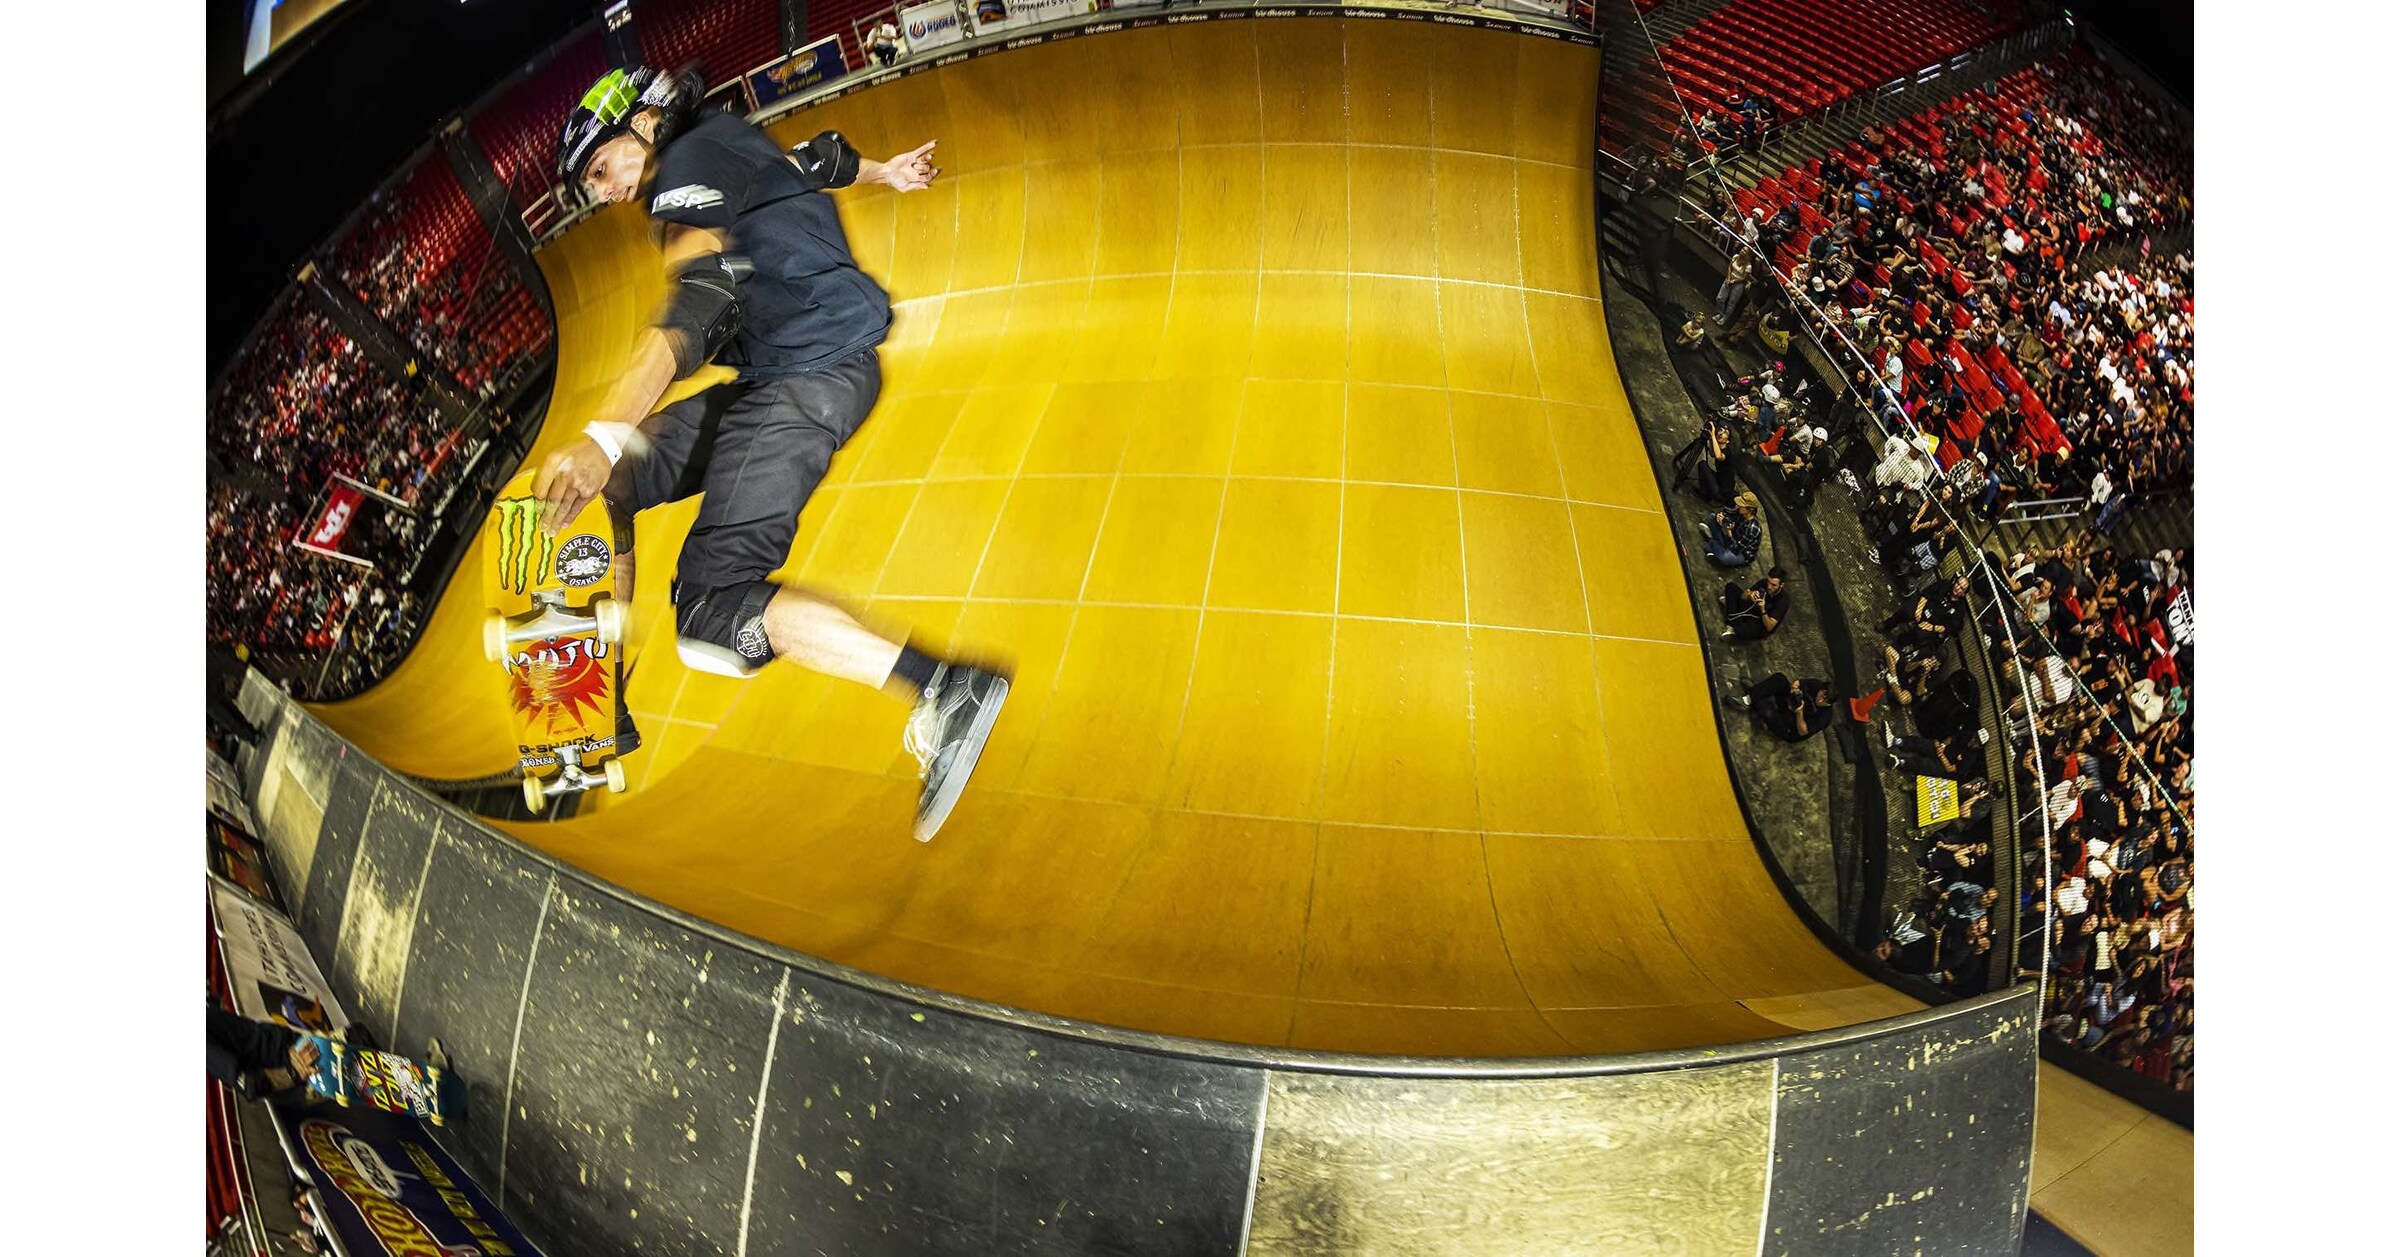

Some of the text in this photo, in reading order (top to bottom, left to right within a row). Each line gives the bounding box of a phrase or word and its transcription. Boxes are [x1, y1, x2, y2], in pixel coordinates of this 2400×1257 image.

[1010, 0, 1077, 14] COMMISSI
[560, 537, 608, 560] SIMPLE CITY
[578, 548, 588, 557] 13
[569, 575, 599, 587] OSAKA
[582, 735, 615, 754] VANS
